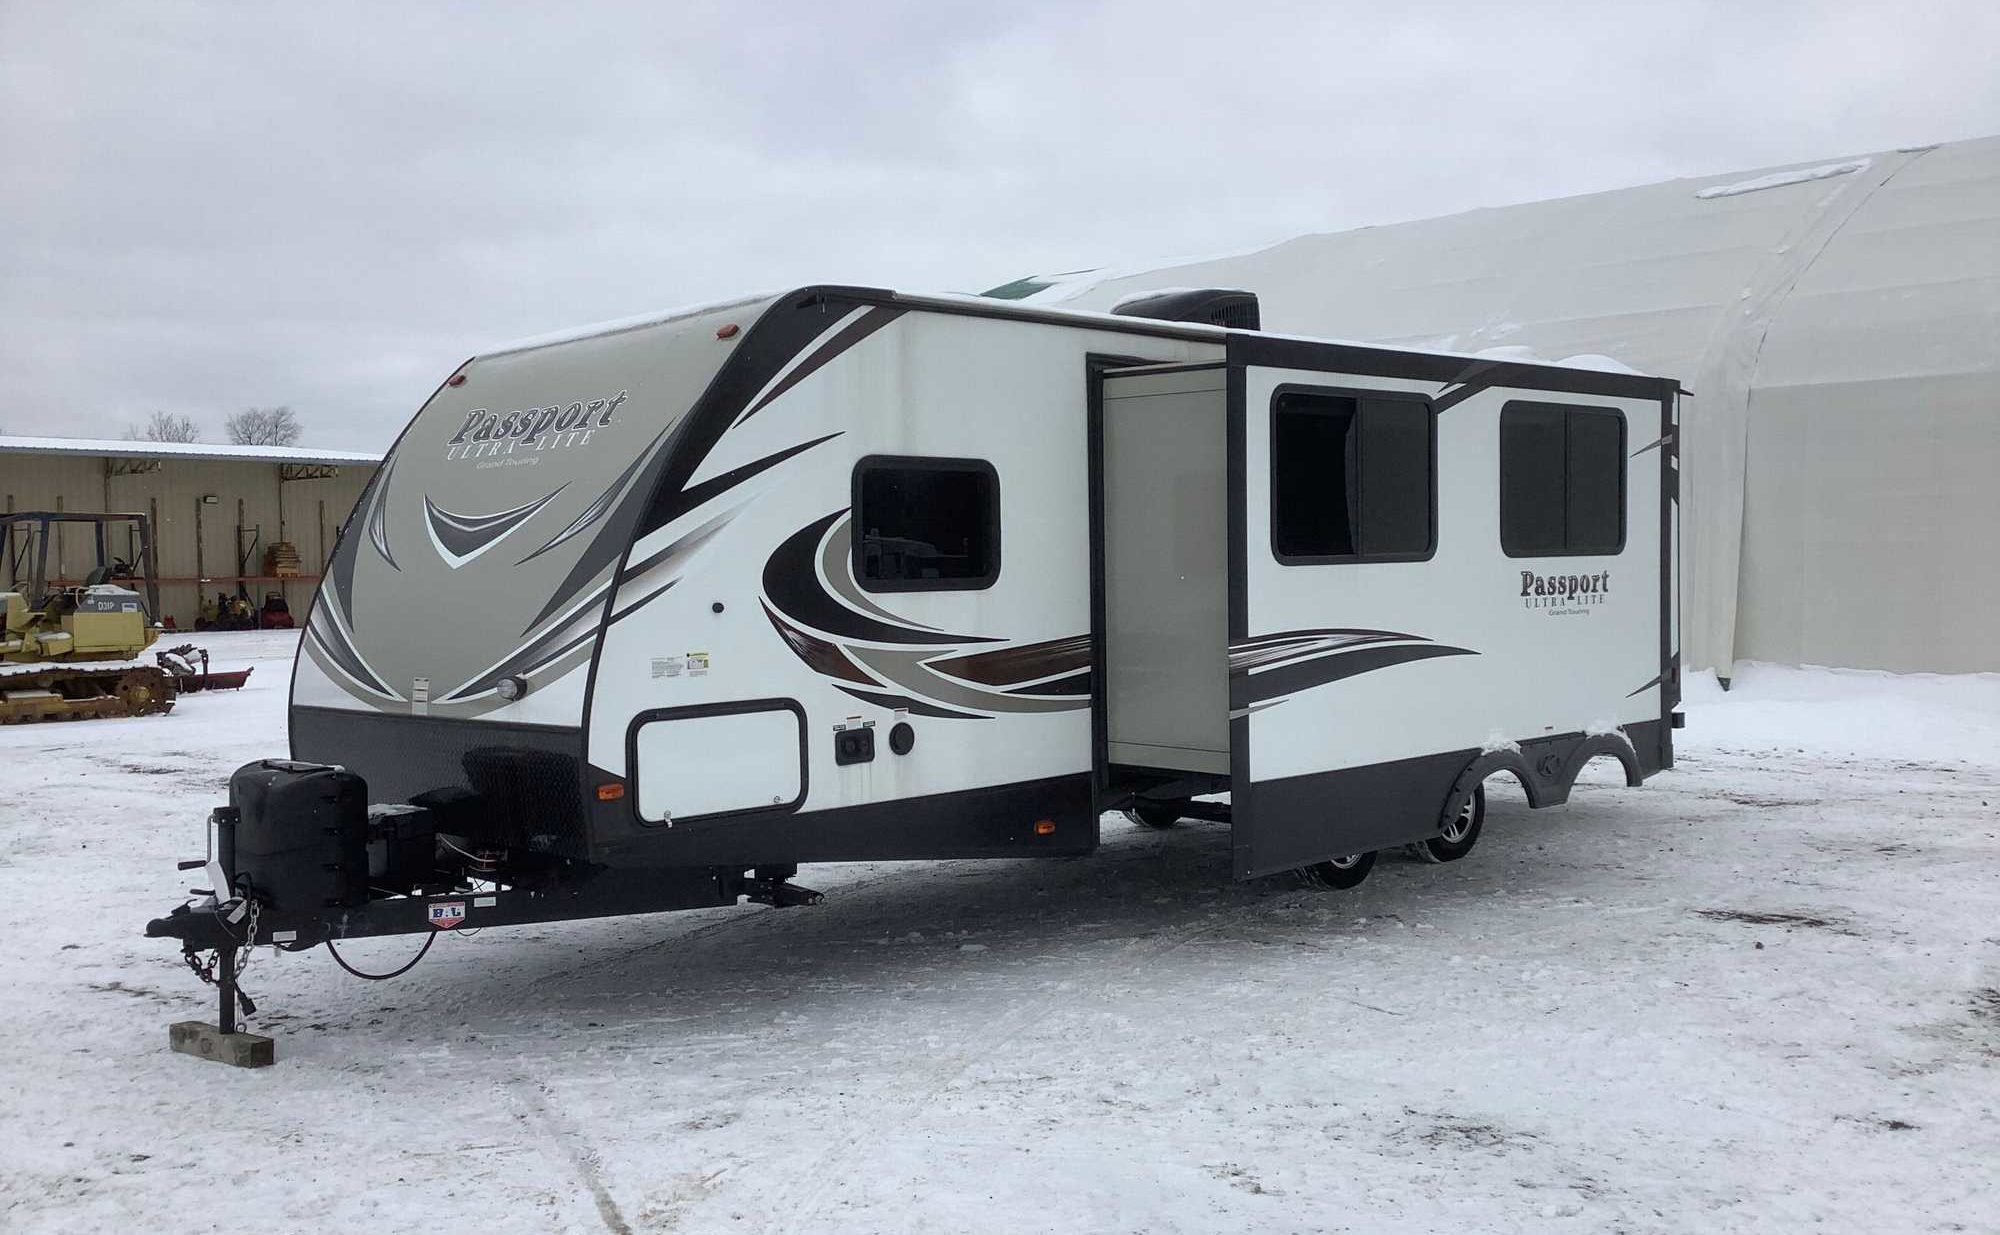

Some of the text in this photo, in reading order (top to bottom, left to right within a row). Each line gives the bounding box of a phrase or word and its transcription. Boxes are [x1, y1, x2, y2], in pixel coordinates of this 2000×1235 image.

[448, 389, 628, 446] Passport
[447, 430, 596, 460] ULTRA LITE
[1520, 570, 1609, 600] Passport
[1524, 594, 1605, 609] ULTRA LITE
